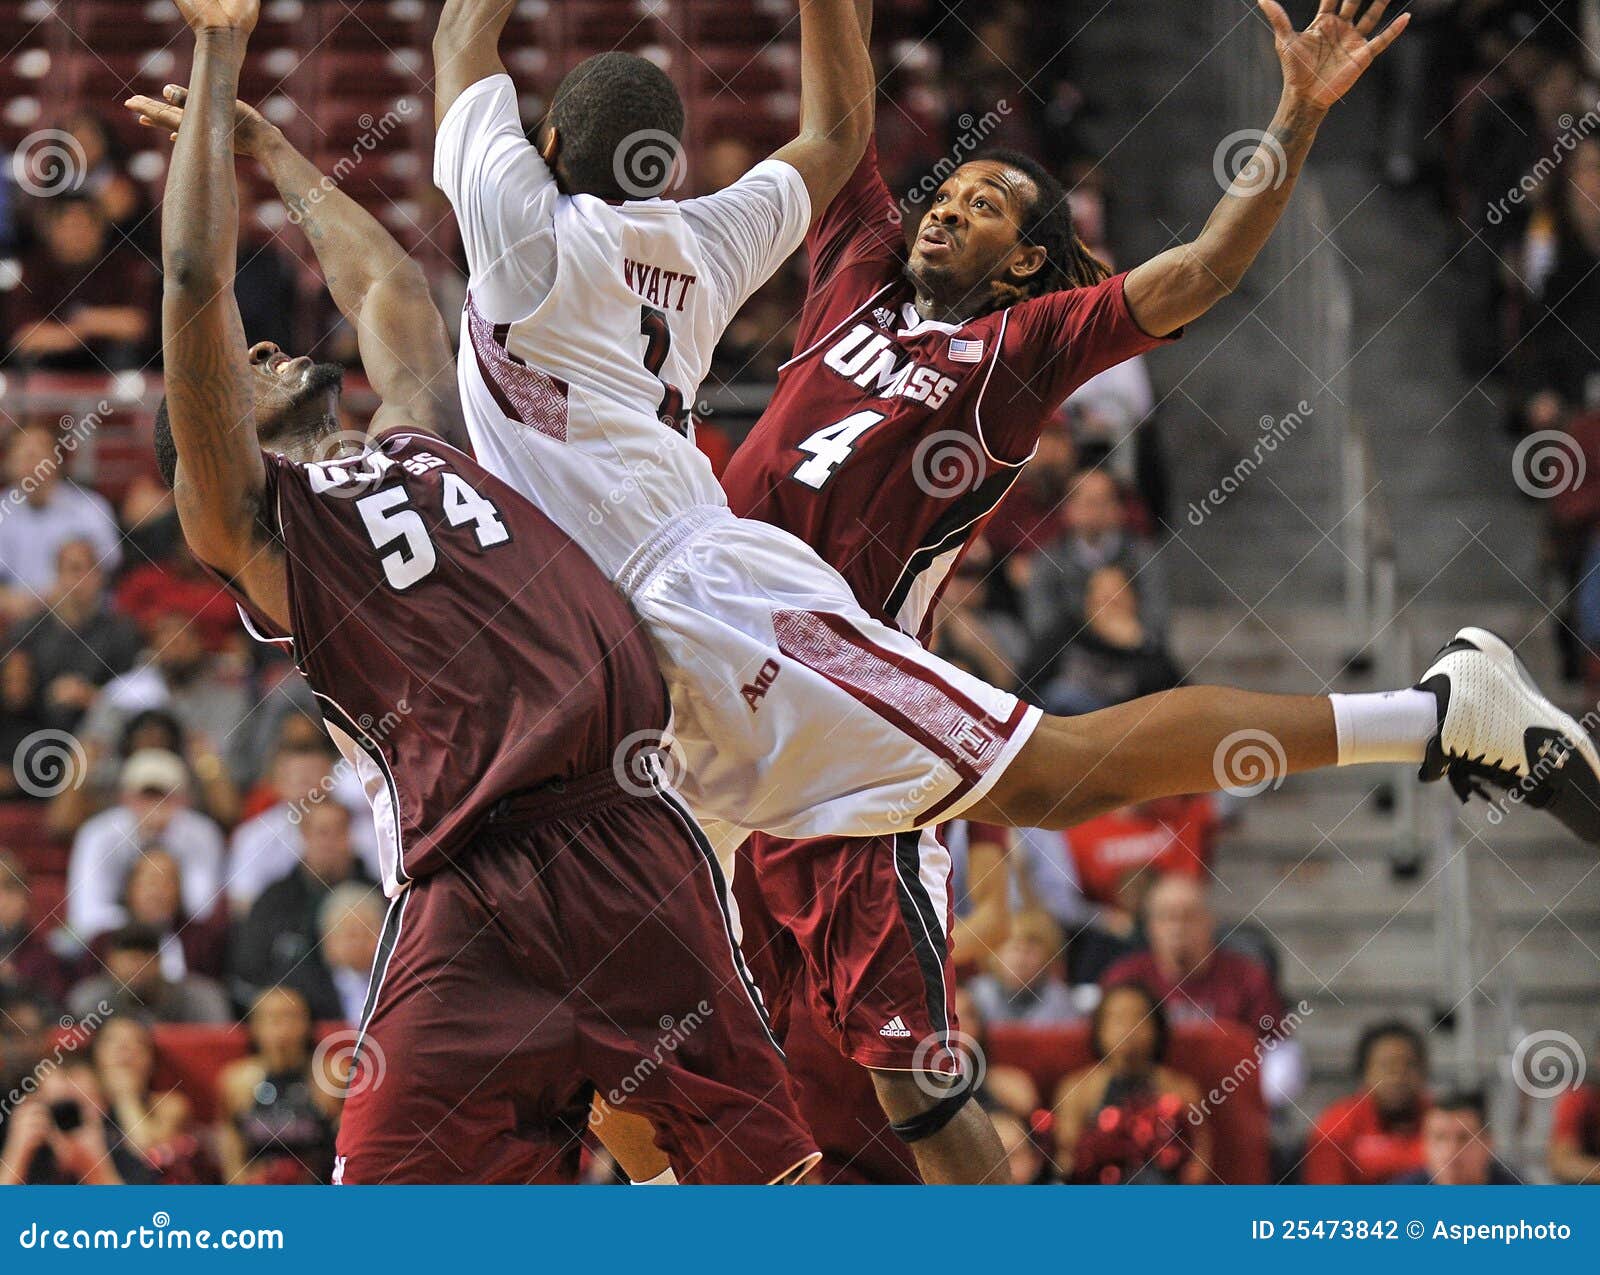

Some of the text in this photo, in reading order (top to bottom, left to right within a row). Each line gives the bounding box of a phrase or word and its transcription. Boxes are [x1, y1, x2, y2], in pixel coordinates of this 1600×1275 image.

[624, 257, 697, 312] WYATT
[792, 408, 887, 491] 4
[354, 470, 511, 591] 54
[879, 1029, 912, 1037] adidas
